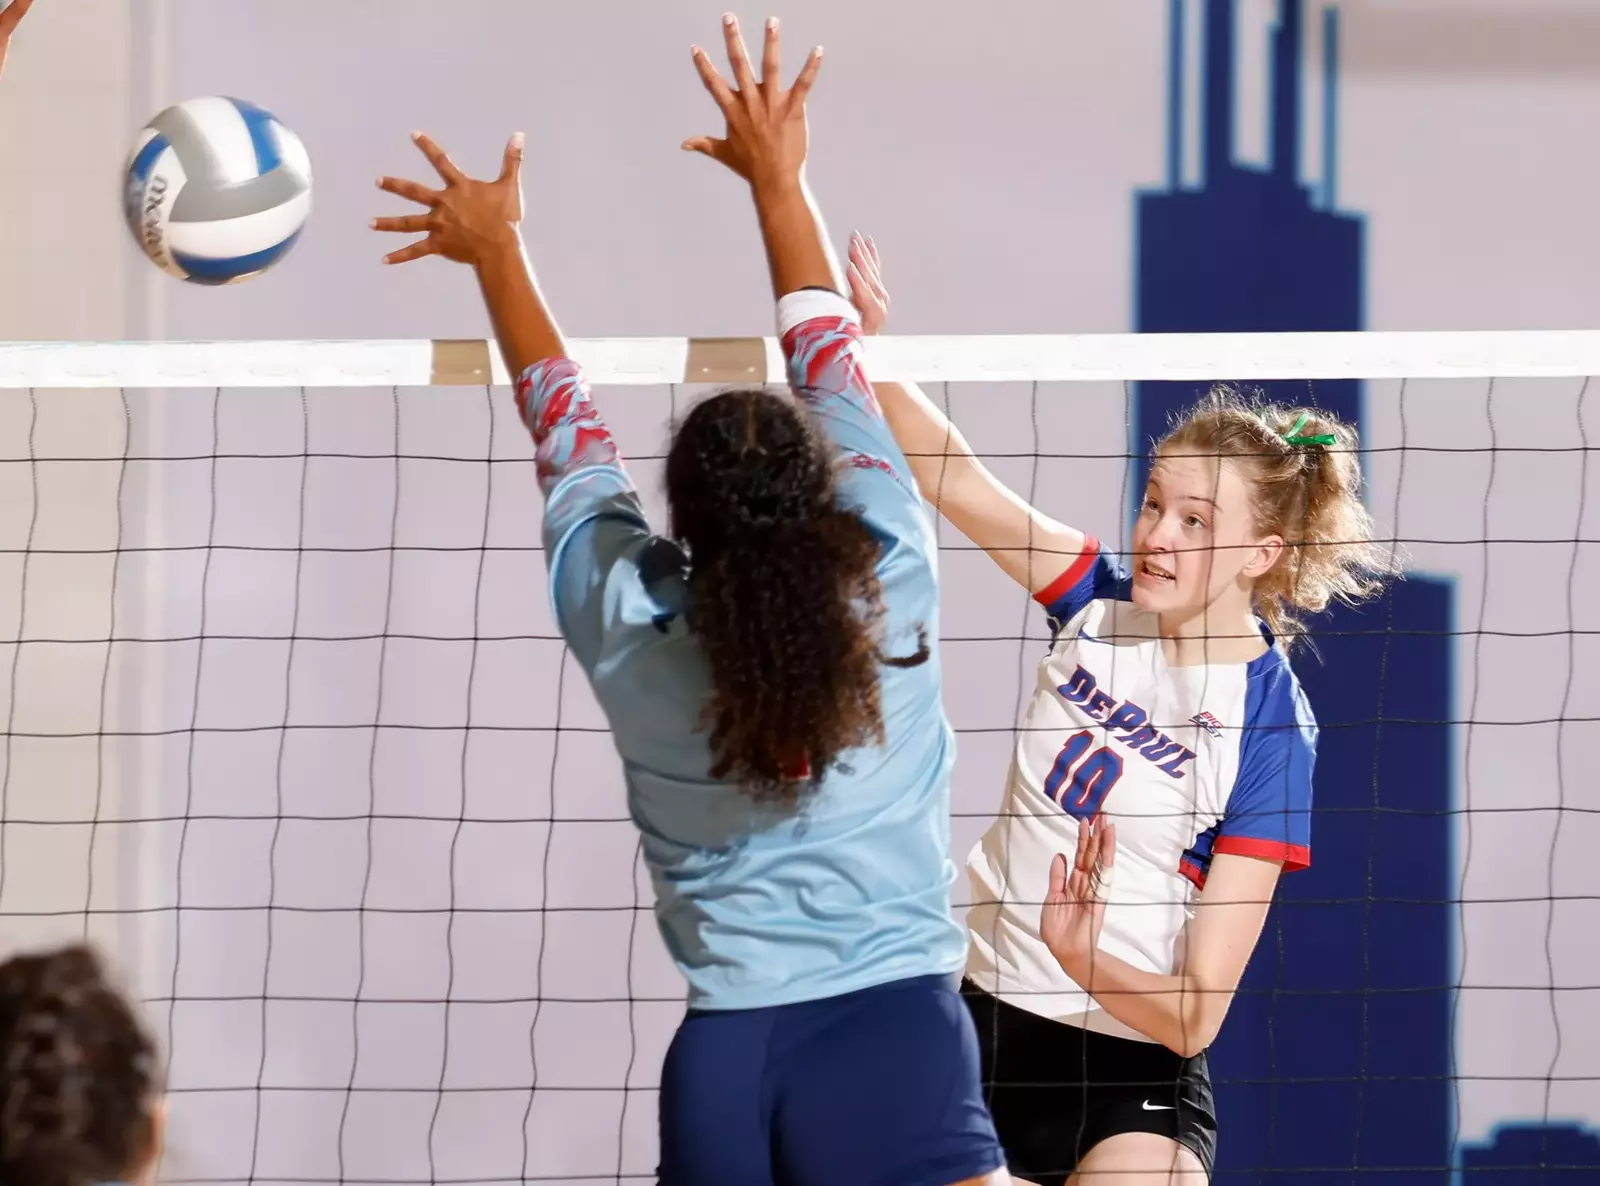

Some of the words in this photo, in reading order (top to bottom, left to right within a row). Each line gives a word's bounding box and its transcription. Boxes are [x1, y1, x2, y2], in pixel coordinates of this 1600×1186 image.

[1191, 714, 1225, 739] EAST
[1199, 711, 1224, 729] BIG
[1044, 729, 1124, 825] 10
